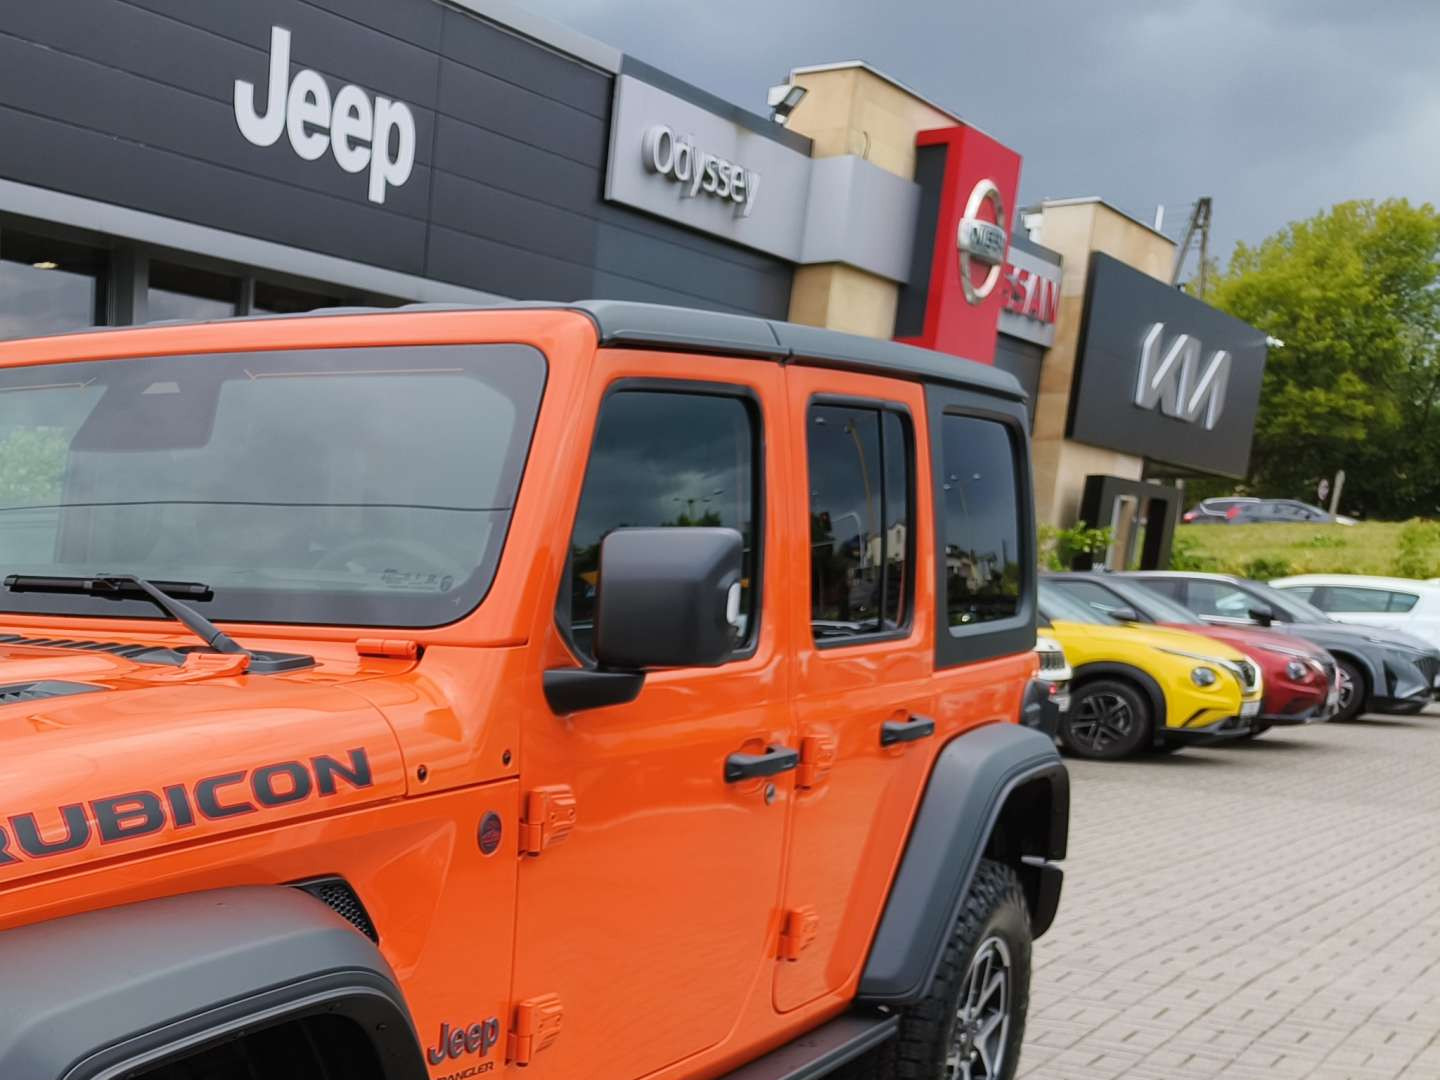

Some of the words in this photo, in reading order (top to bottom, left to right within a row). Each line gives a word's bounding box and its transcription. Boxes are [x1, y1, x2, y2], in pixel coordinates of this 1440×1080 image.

[233, 25, 416, 205] Jeep
[642, 125, 759, 217] Odyssey
[427, 1016, 499, 1066] Jeep
